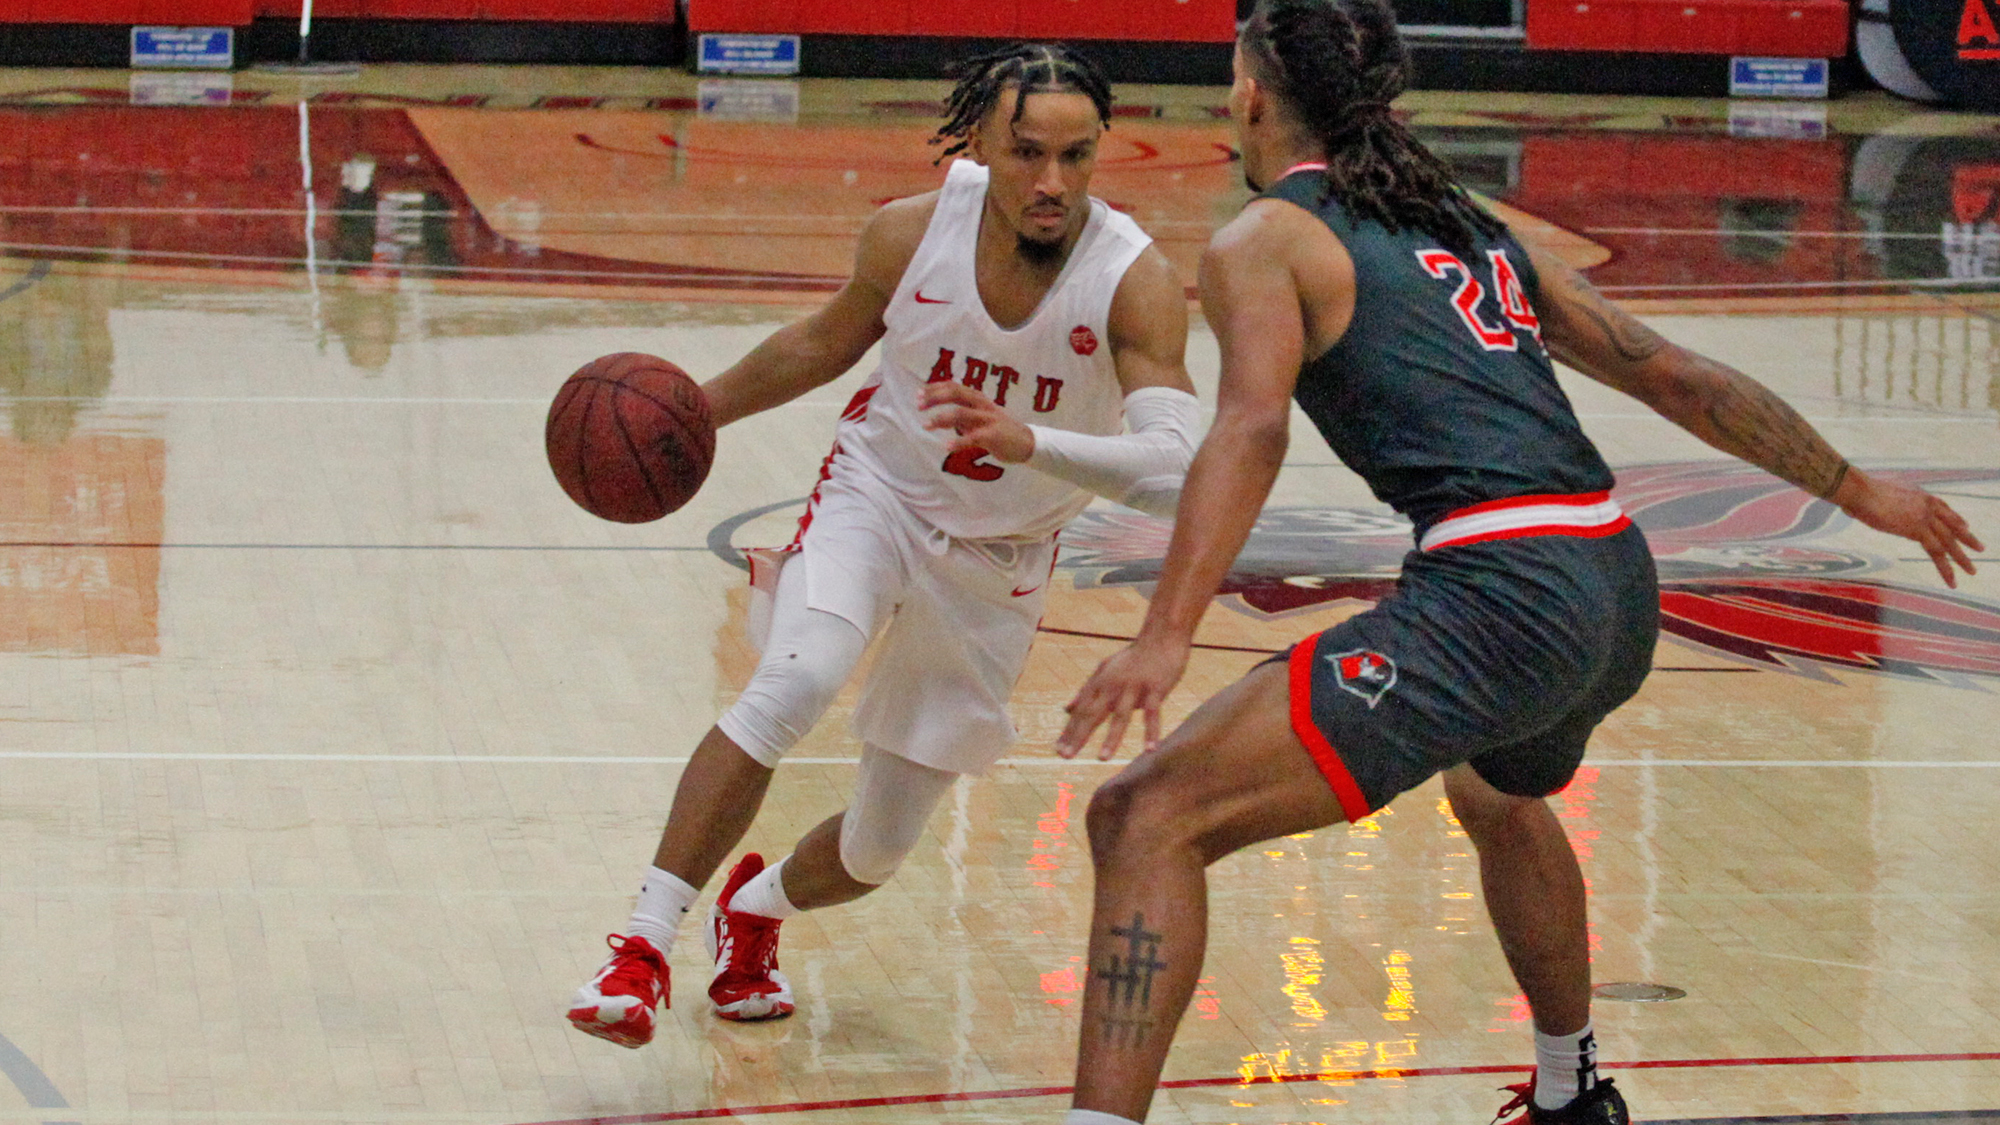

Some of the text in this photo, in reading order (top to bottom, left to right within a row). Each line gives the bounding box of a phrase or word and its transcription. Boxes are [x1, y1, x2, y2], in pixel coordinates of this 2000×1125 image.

[1957, 0, 2000, 45] A
[1415, 249, 1549, 356] 24
[927, 347, 1064, 413] ART U
